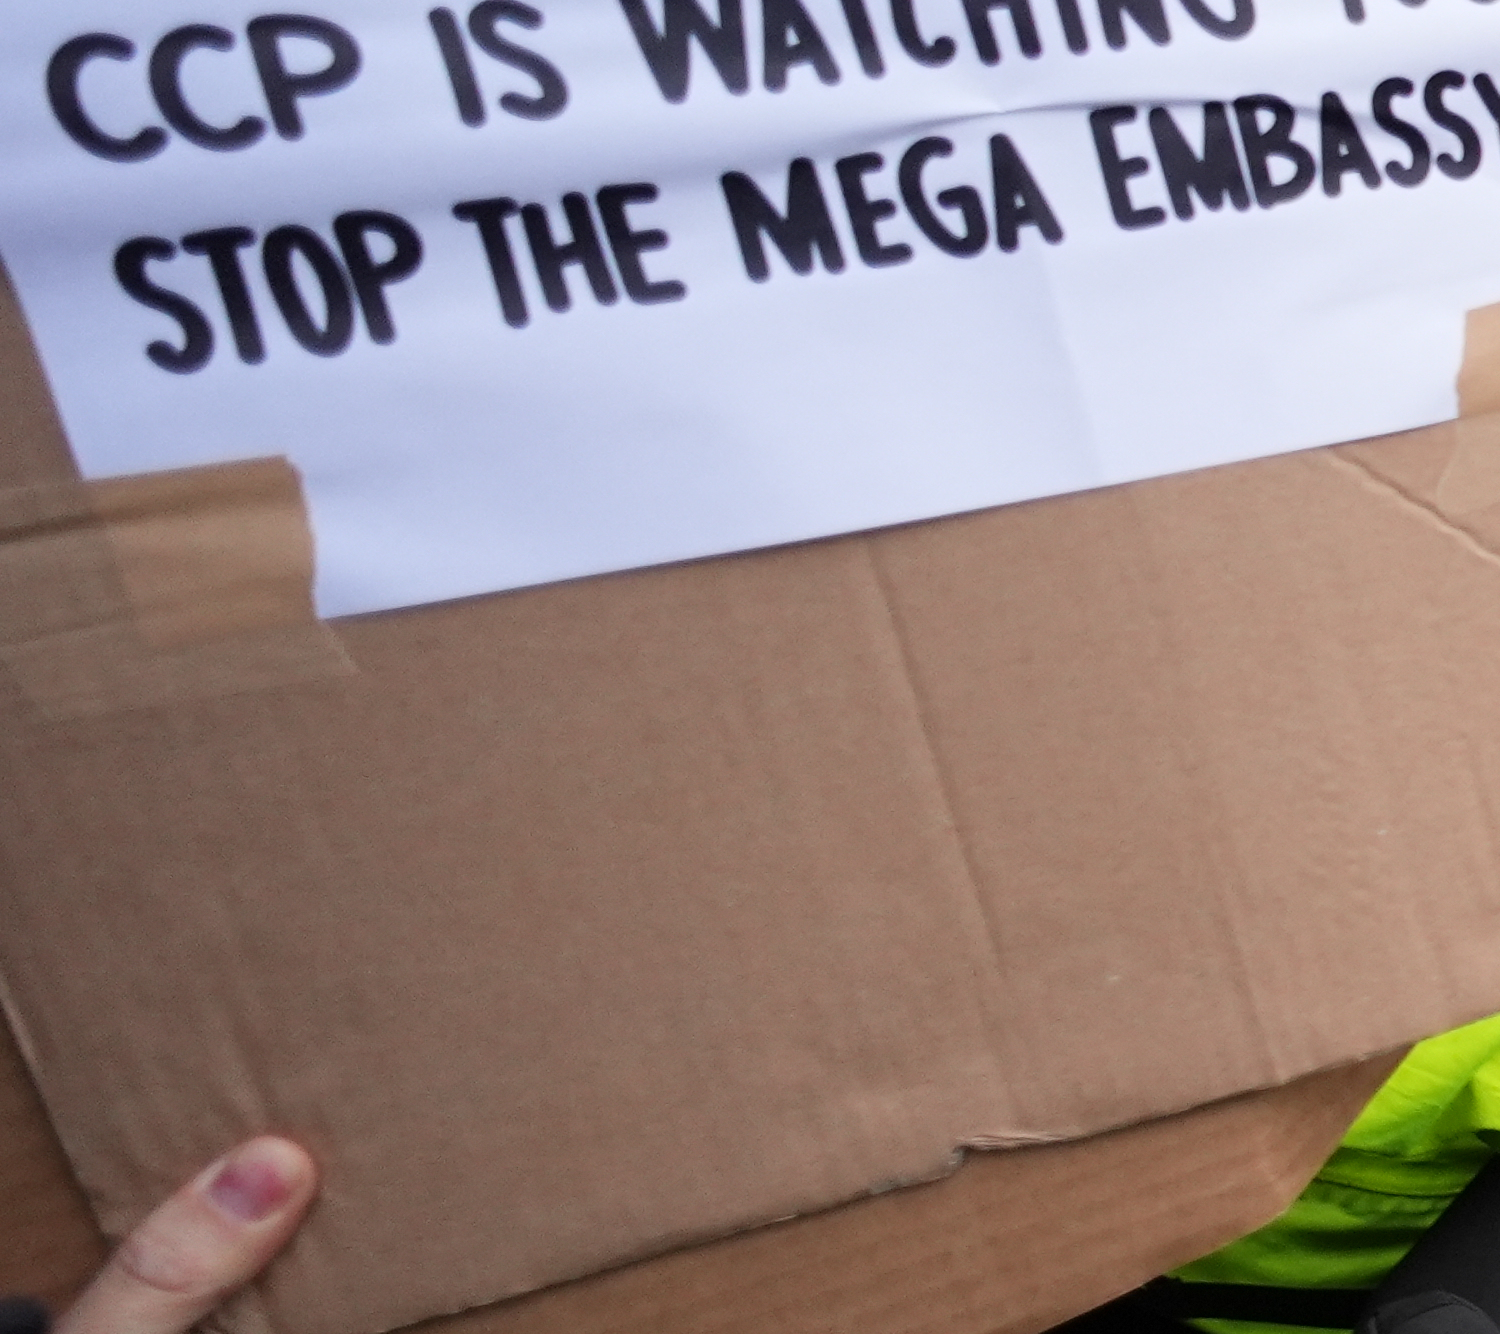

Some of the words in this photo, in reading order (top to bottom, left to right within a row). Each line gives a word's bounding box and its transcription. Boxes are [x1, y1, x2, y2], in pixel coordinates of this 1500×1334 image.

[44, 12, 362, 165] CCP
[110, 208, 424, 376] STOP
[450, 180, 686, 328] THE
[717, 132, 1064, 281] MEGA
